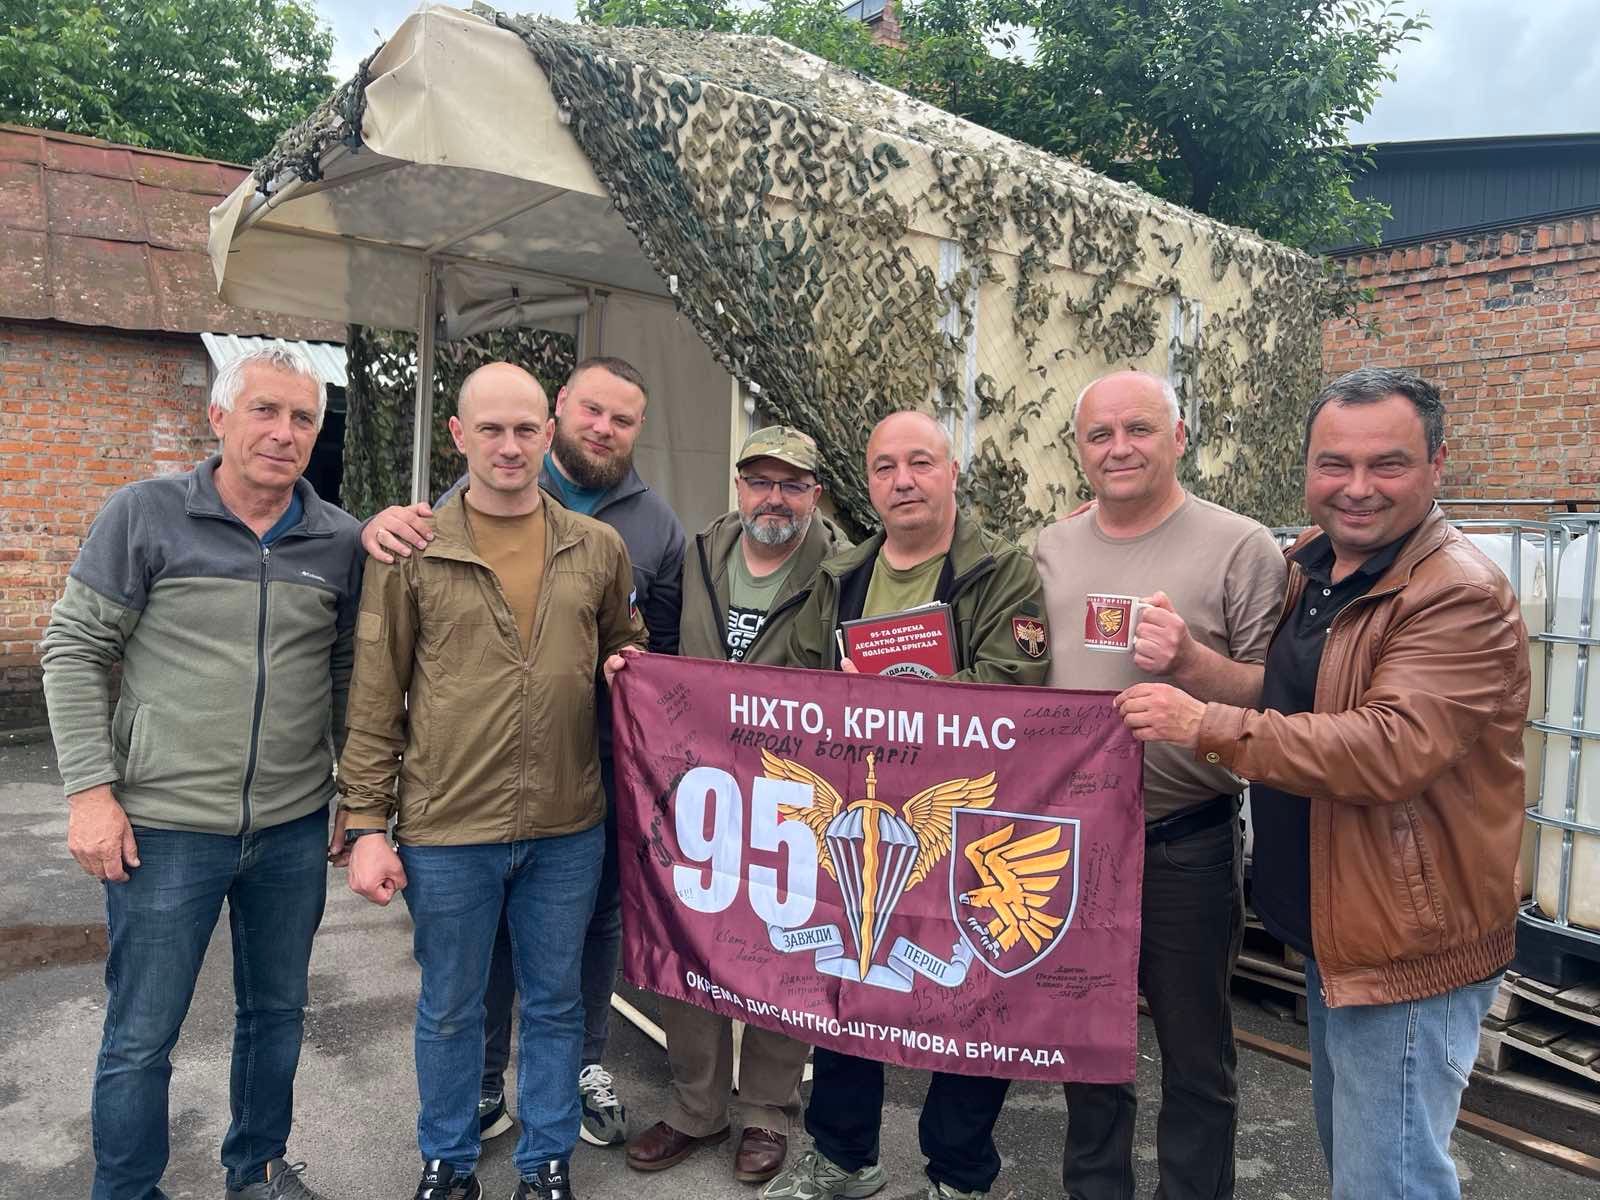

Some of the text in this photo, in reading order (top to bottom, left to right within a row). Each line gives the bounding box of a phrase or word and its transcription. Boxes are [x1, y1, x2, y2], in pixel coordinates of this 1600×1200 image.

[862, 640, 938, 657] ПОЛІСЬКА БРИГАДА
[870, 624, 925, 639] 95-ТА ОКРЕМА
[729, 693, 832, 741] НІХТО,
[844, 706, 924, 744] КРІМ
[937, 714, 1016, 750] НАС
[729, 727, 803, 758] НАРОДУ
[815, 739, 921, 766] БОЛГАРІЇ
[673, 766, 817, 928] 95
[782, 927, 833, 948] ЗАВЖДИ
[903, 943, 948, 979] ПЕРШІ
[686, 971, 744, 1008] ОКРЕМА
[965, 1042, 1065, 1067] БРИГАДА
